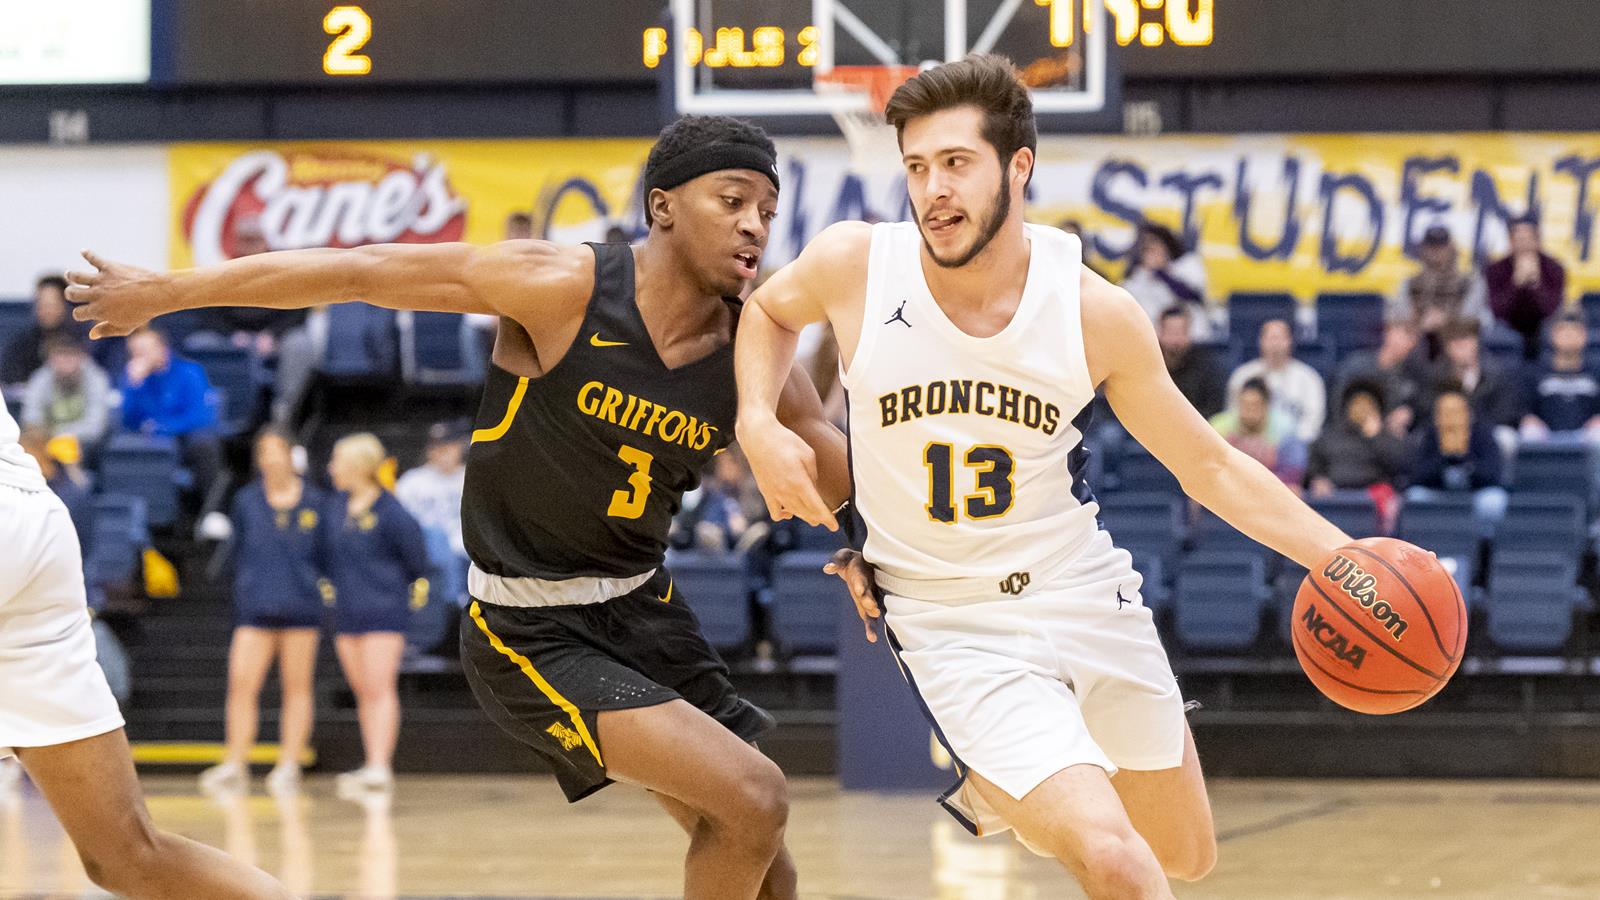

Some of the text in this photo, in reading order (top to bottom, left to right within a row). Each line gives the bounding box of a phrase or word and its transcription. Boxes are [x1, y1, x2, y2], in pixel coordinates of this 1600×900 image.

[323, 6, 371, 75] 2
[192, 149, 468, 270] Cane's
[577, 381, 718, 451] GRIFFONS
[878, 379, 1061, 437] BRONCHOS
[607, 444, 654, 519] 3
[922, 441, 1016, 525] 13
[998, 571, 1031, 595] UCO
[1322, 553, 1409, 642] Wilson
[1301, 603, 1368, 671] NCAA
